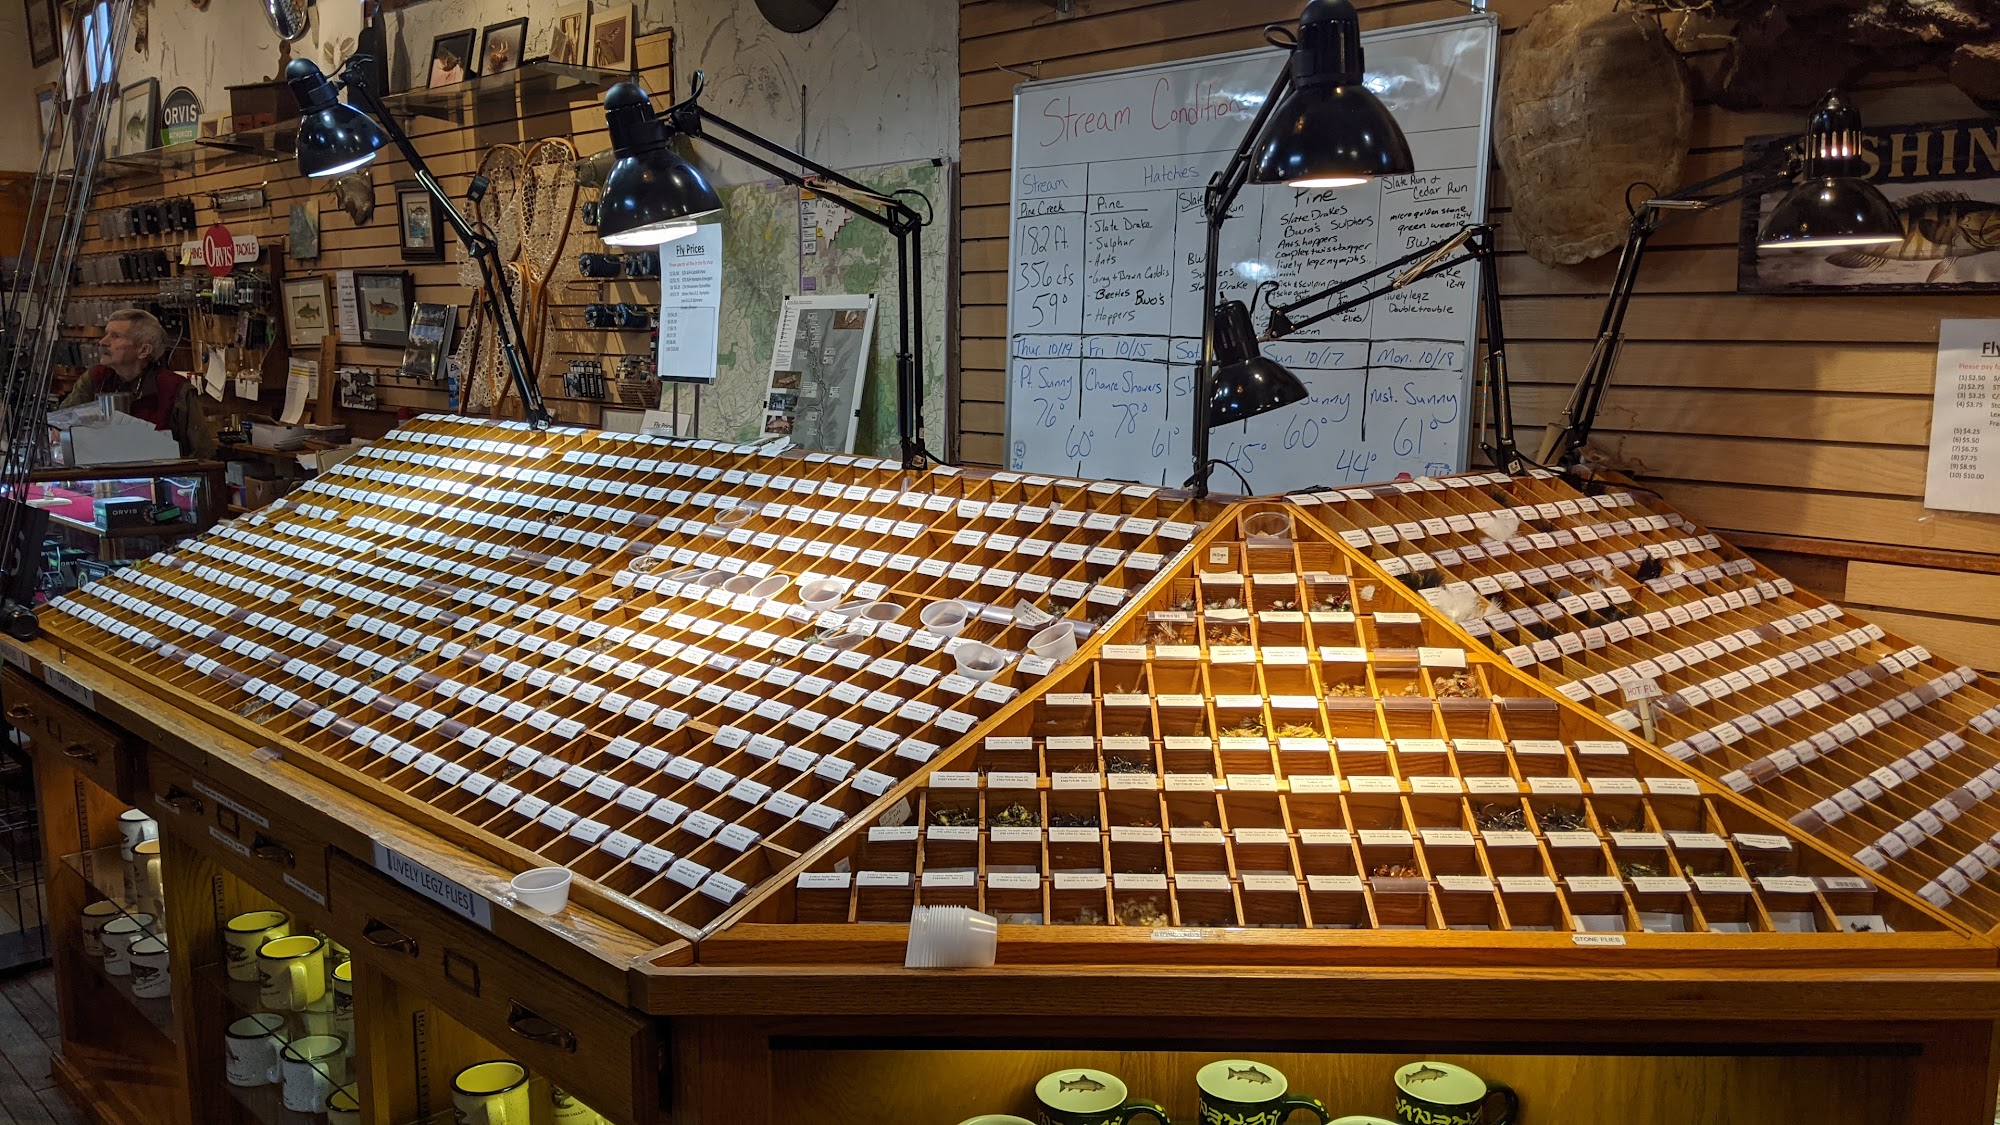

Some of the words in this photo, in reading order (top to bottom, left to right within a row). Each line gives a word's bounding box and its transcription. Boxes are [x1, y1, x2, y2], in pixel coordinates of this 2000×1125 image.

[164, 104, 197, 125] ORVIS
[1040, 96, 1130, 147] Stream
[1861, 126, 2000, 180] SHIN
[1144, 165, 1200, 187] Hatches
[1410, 175, 1426, 186] Run
[1023, 174, 1068, 195] Stream
[1413, 185, 1442, 200] Cedar
[1447, 182, 1468, 195] Run
[1020, 202, 1035, 216] Pine
[1037, 200, 1065, 214] Creek
[1097, 197, 1124, 209] Pine
[1179, 191, 1204, 210] Slate
[1123, 217, 1153, 232] Drake
[1397, 224, 1426, 237] green
[205, 235, 233, 267] ORVIS
[235, 242, 256, 256] TACKLE
[676, 244, 685, 256] Fly
[686, 243, 705, 254] Prices
[1096, 236, 1135, 252] Sulphur
[1094, 253, 1116, 267] Ants
[1187, 252, 1206, 265] BW
[1277, 260, 1302, 273] lively
[1016, 260, 1052, 292] 356
[1056, 264, 1074, 287] cfs
[1218, 280, 1248, 291] Drake
[1095, 288, 1131, 301] Beetles
[1095, 307, 1136, 326] Hoppers
[1089, 338, 1104, 356] Fri
[1115, 338, 1153, 358] 10/15
[1305, 346, 1345, 368] 10/17
[1377, 349, 1412, 365] Mon.
[1038, 366, 1073, 401] Sunny
[1122, 371, 1162, 393] Showers
[1299, 381, 1351, 423] Sunny
[1404, 382, 1458, 424] Sunny
[1957, 392, 1965, 400] (3)
[1968, 392, 1985, 400] $3.25
[1956, 401, 1964, 409] (4)
[1966, 401, 1983, 409] $3.75
[112, 508, 138, 516] ORVIS
[1627, 686, 1641, 697] HOT
[393, 856, 419, 882] LIVELY
[421, 872, 443, 896] LEGZ
[446, 885, 469, 910] FLIES
